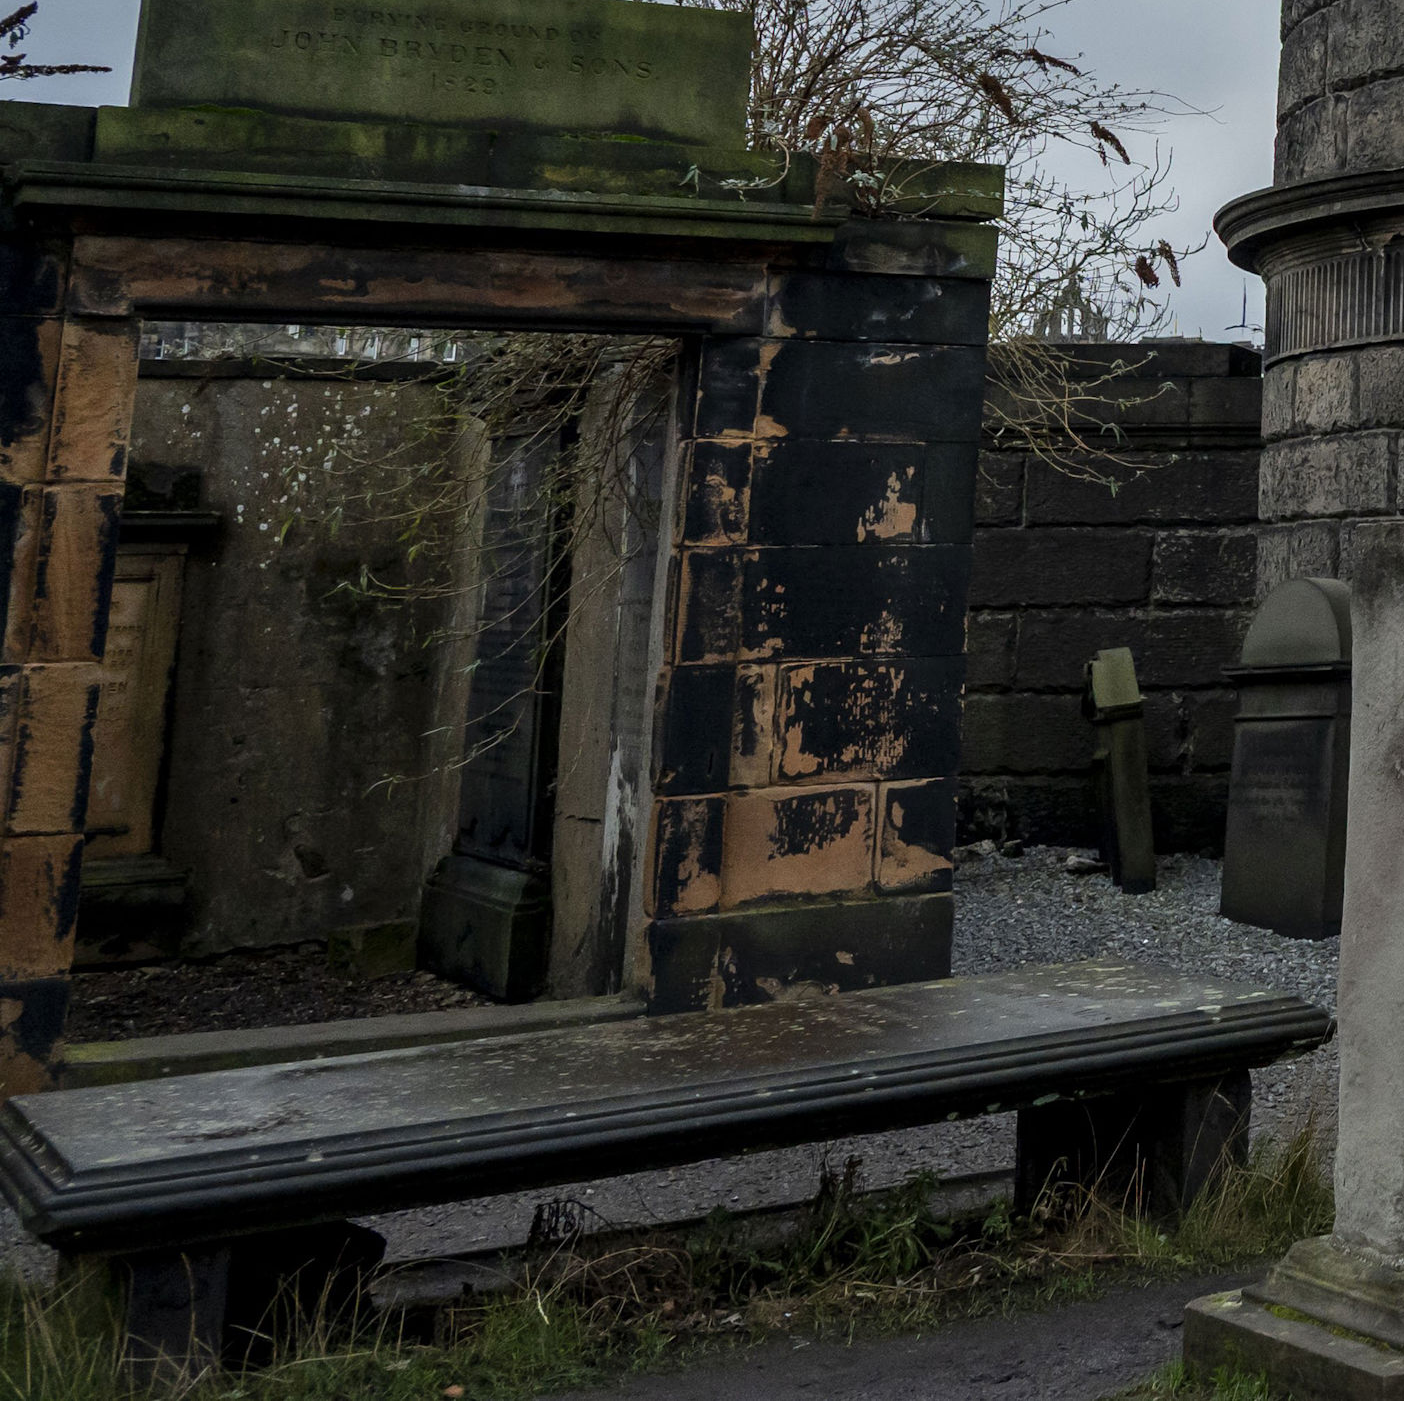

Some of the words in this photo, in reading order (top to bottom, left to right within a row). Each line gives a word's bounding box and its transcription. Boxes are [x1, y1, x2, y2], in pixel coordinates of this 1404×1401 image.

[460, 16, 559, 41] GROUND
[270, 29, 361, 55] JOHN
[379, 38, 514, 68] BRYDEN
